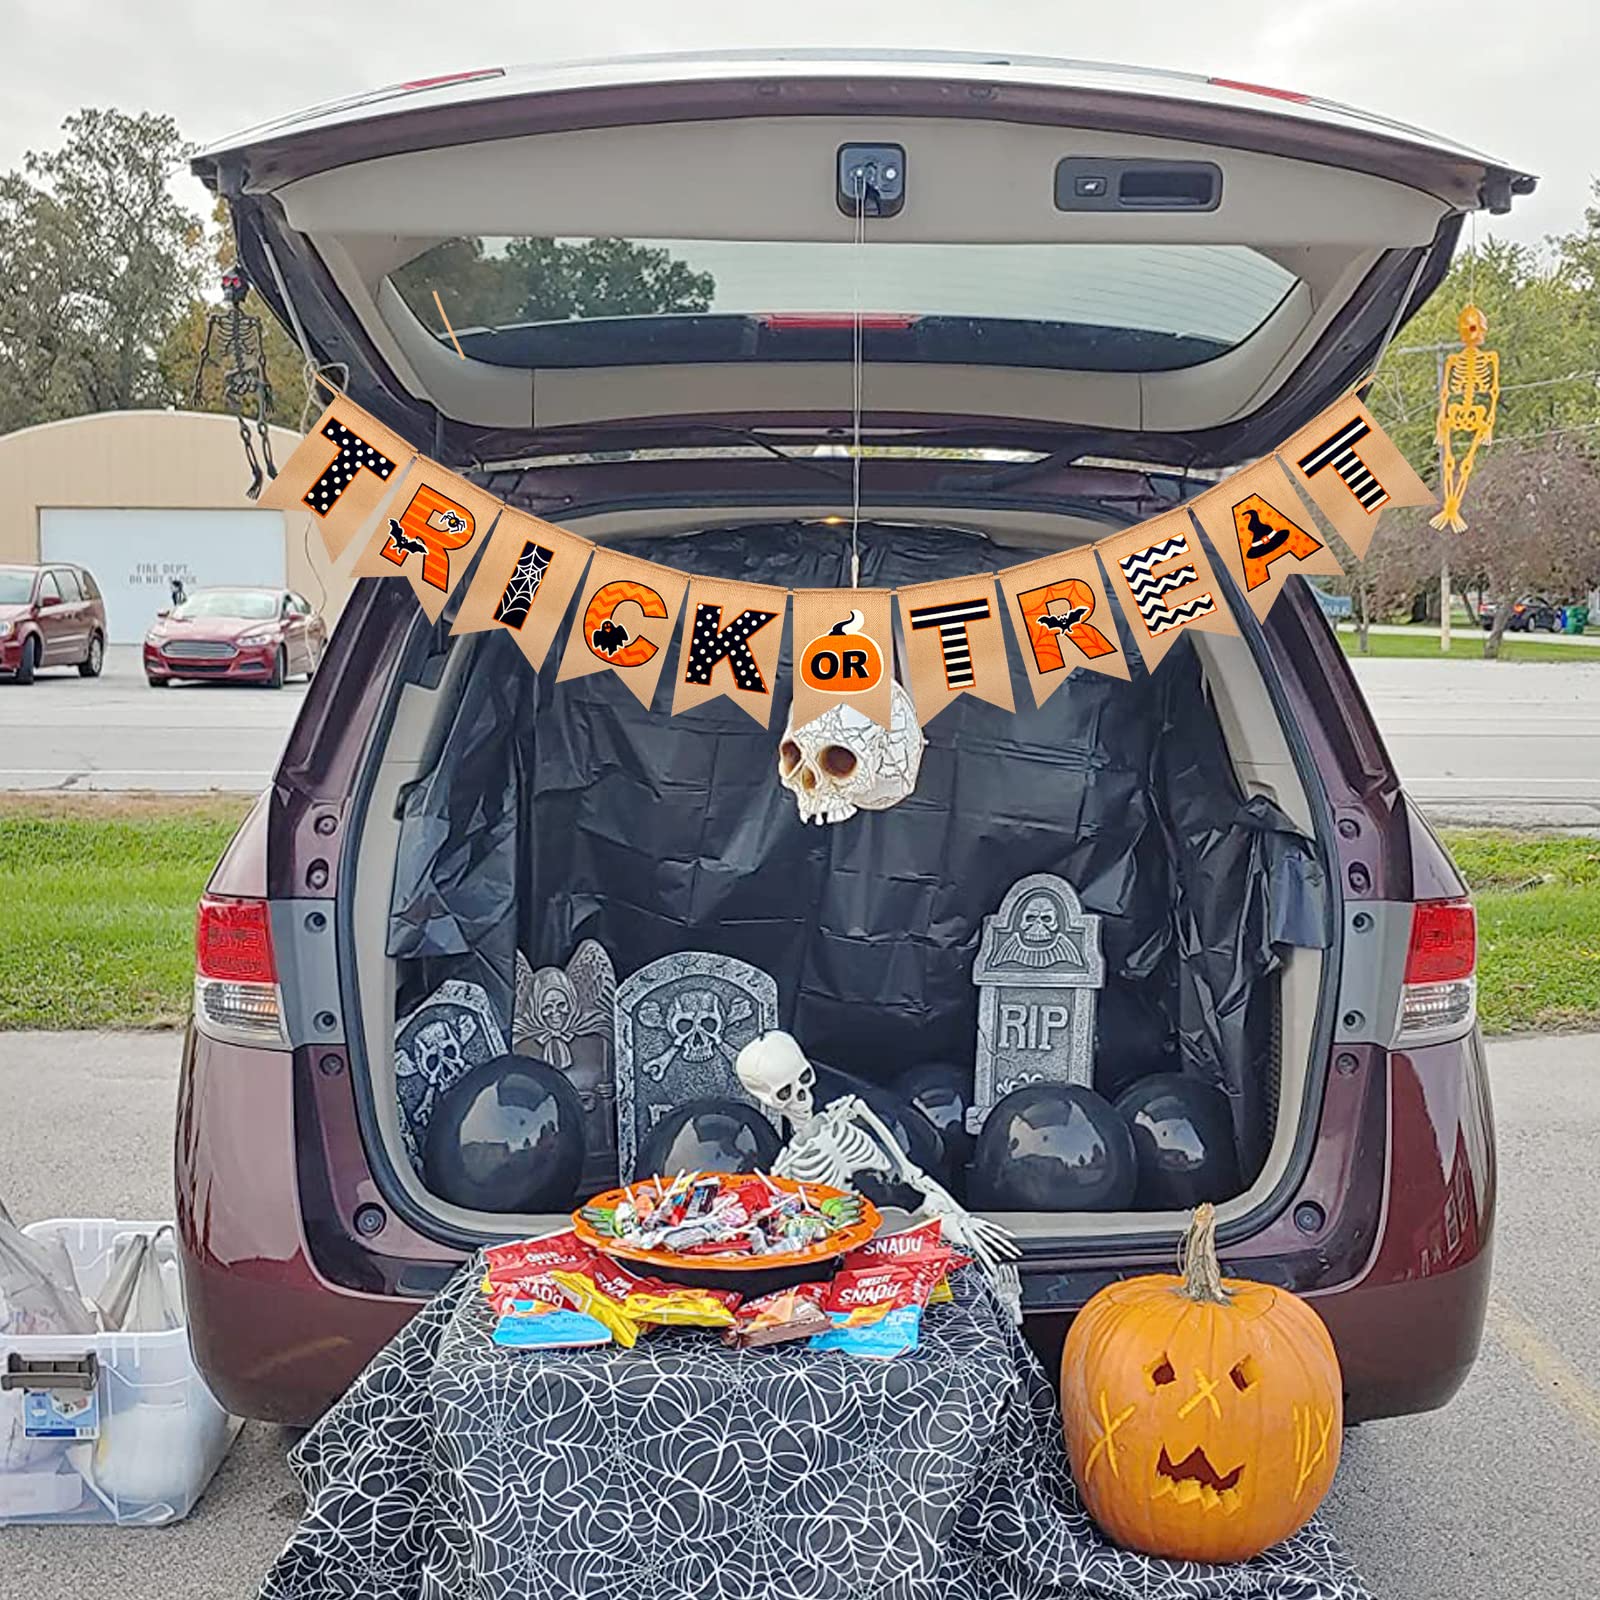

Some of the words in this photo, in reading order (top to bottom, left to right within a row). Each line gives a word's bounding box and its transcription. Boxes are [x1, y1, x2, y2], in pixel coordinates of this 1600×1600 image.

[302, 416, 779, 695] TRICK
[810, 651, 869, 680] OR
[909, 414, 1392, 692] TREAT
[998, 1004, 1068, 1050] RIP
